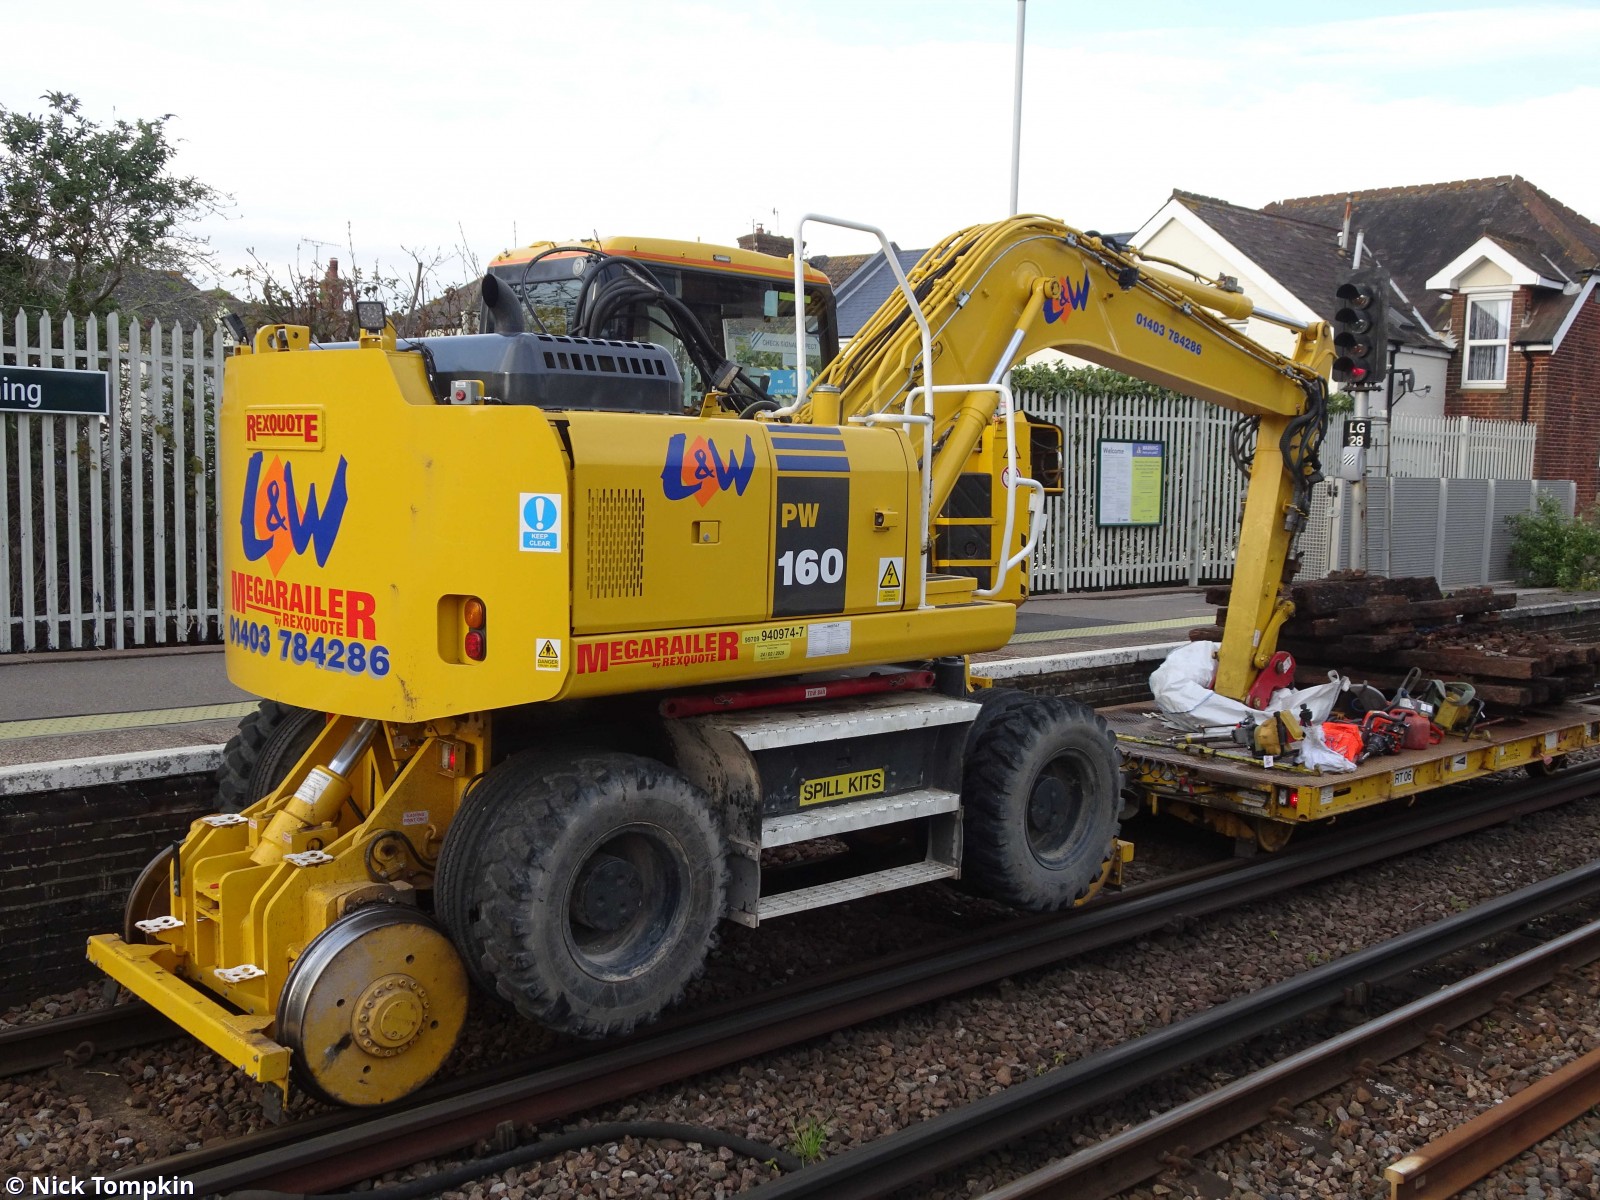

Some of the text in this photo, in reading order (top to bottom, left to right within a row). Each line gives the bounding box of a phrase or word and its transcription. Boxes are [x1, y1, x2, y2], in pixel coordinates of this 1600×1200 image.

[763, 339, 779, 347] CHECK
[1136, 313, 1202, 355] 01403 784286
[0, 376, 42, 409] ing
[246, 414, 318, 443] REXQUOTE
[1349, 422, 1366, 433] LG
[1349, 435, 1364, 447] 28
[1103, 447, 1125, 455] Welcome
[660, 432, 756, 501] L&W
[240, 450, 349, 569] L&W
[781, 503, 820, 529] PW
[777, 548, 844, 586] 160
[231, 570, 377, 641] MEGARAILER
[274, 613, 344, 637] by REXQUOTE
[761, 626, 804, 642] 940974-7
[229, 615, 390, 678] 01403 784286
[576, 631, 739, 675] MEGARAILER
[662, 652, 717, 667] REXQUOTE
[803, 773, 881, 801] SPILL KITS
